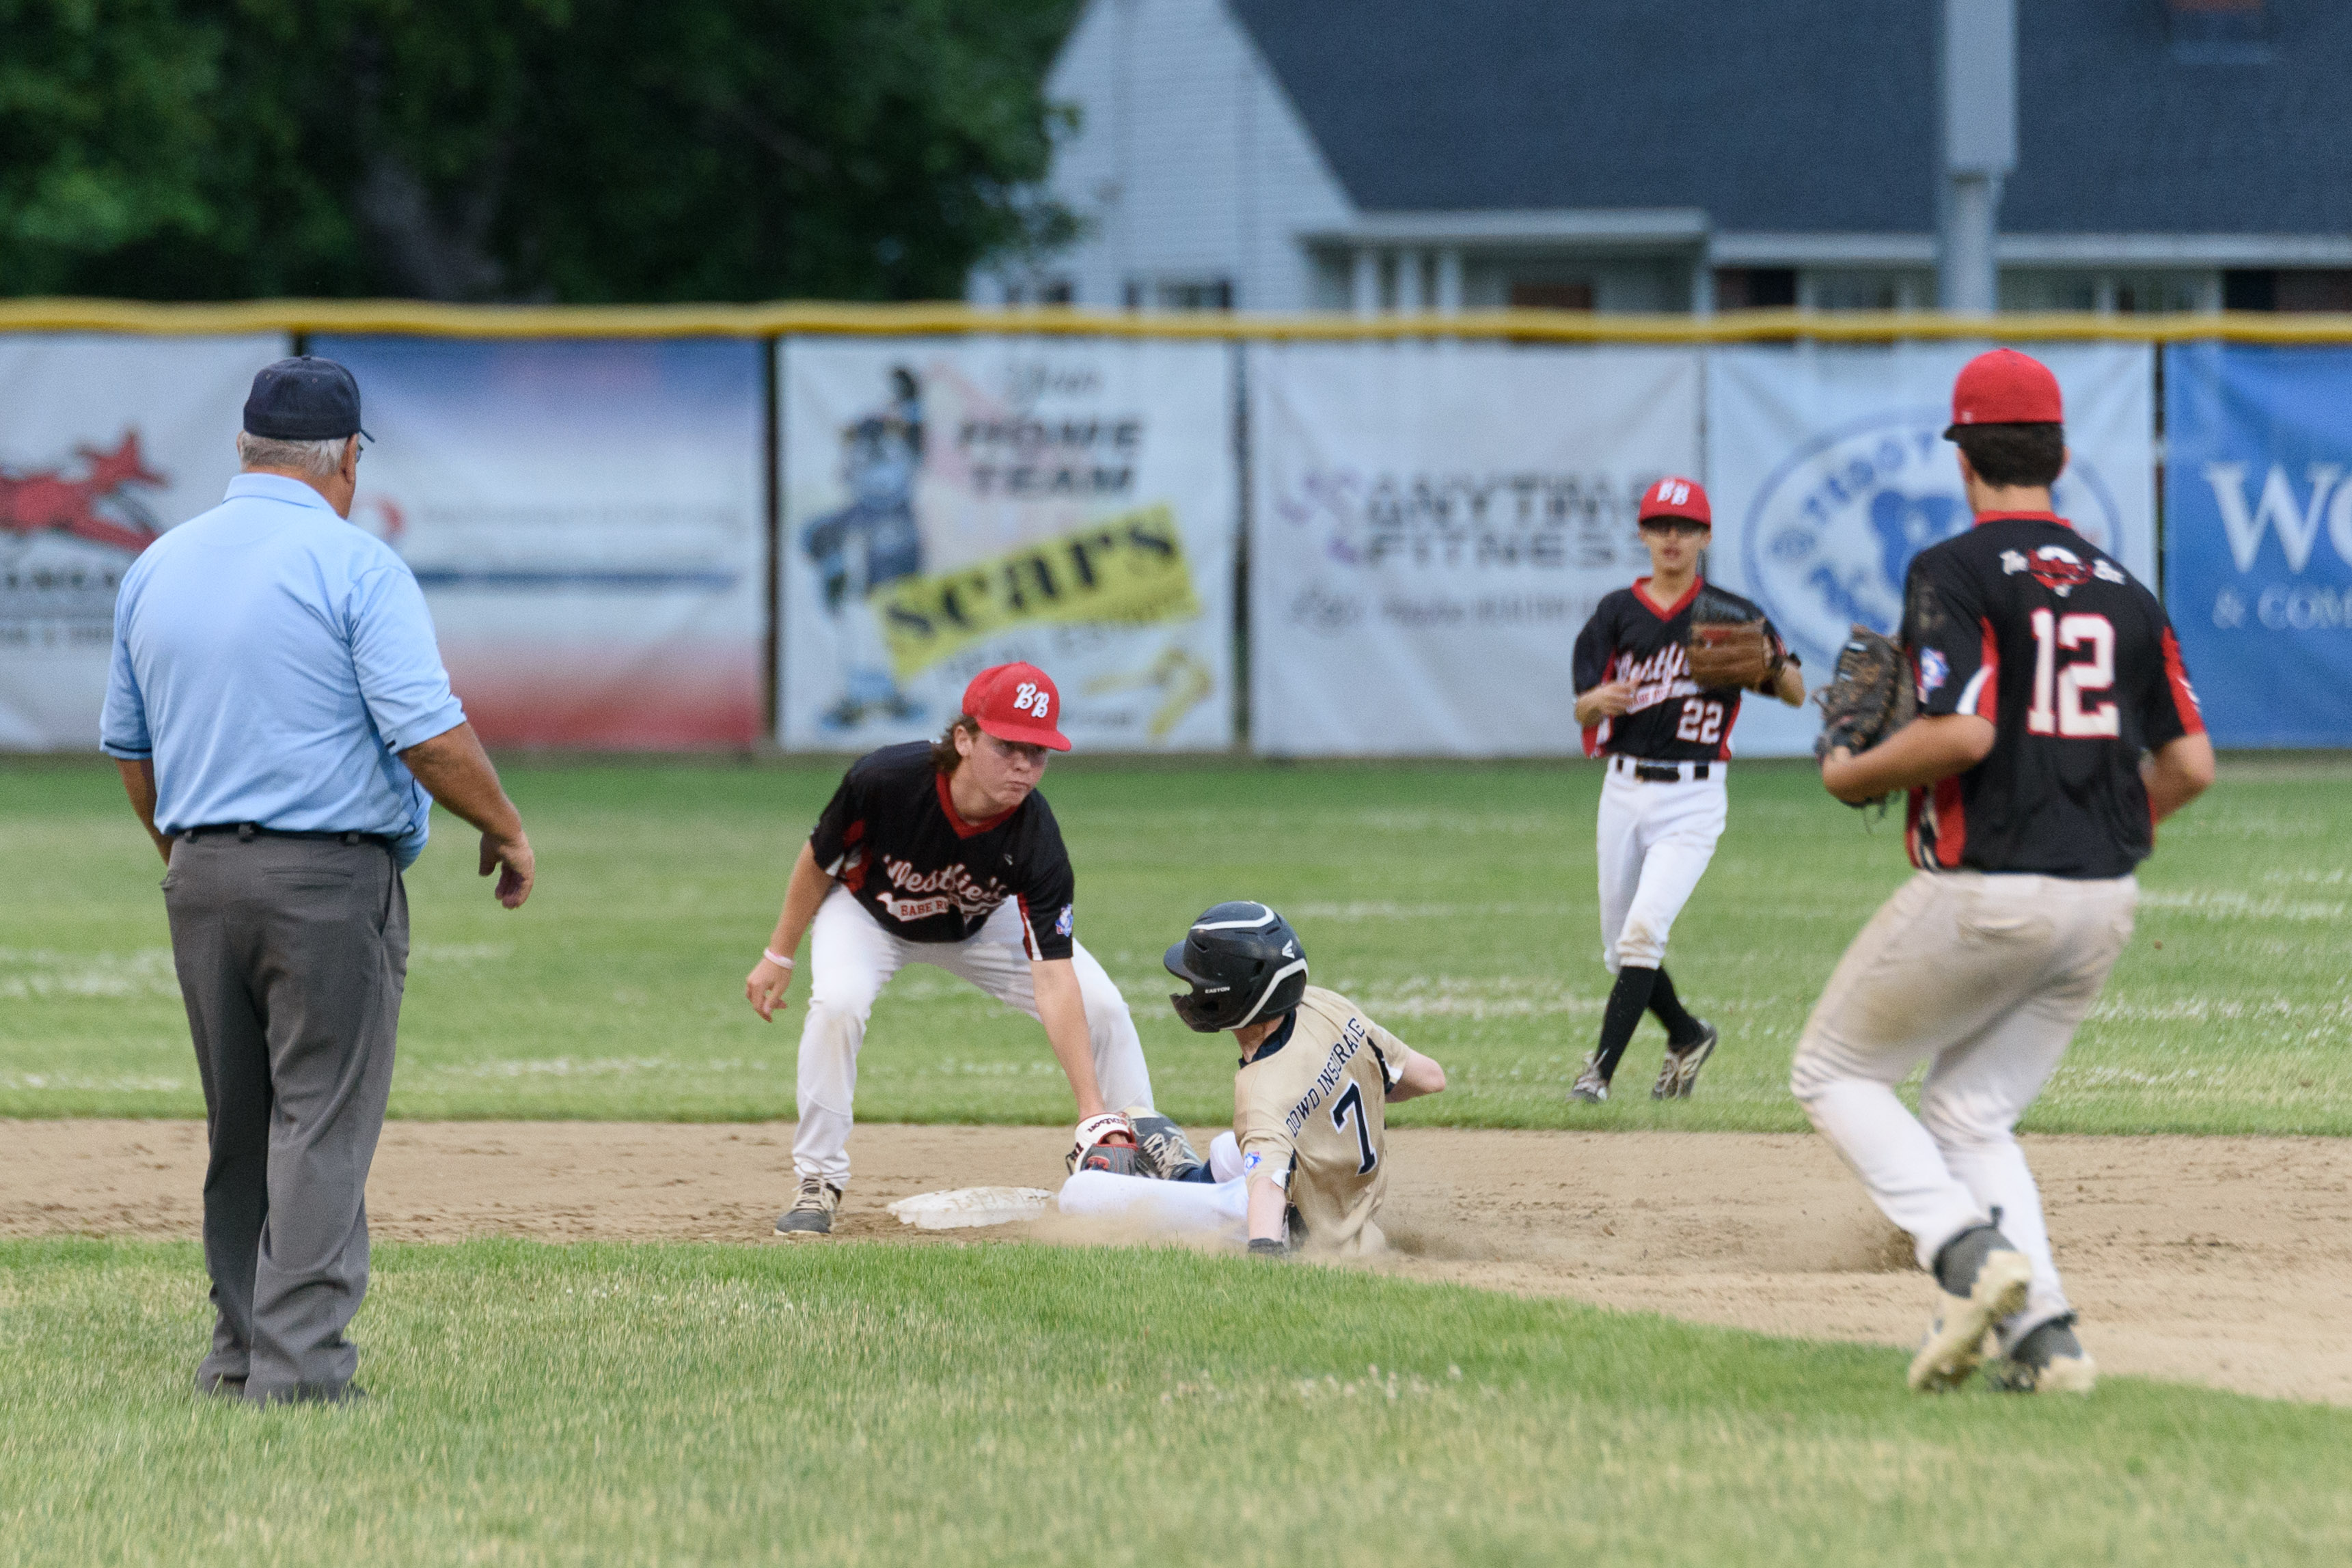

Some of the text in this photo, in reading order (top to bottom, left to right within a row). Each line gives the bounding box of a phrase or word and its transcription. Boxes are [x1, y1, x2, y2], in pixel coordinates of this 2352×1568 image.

[2026, 607, 2120, 740] 12
[1013, 683, 1050, 718] BB
[1676, 696, 1725, 745] 22
[1205, 986, 1231, 994] EASTON
[1286, 1088, 1321, 1138] DOWD
[1330, 1077, 1378, 1177] 7
